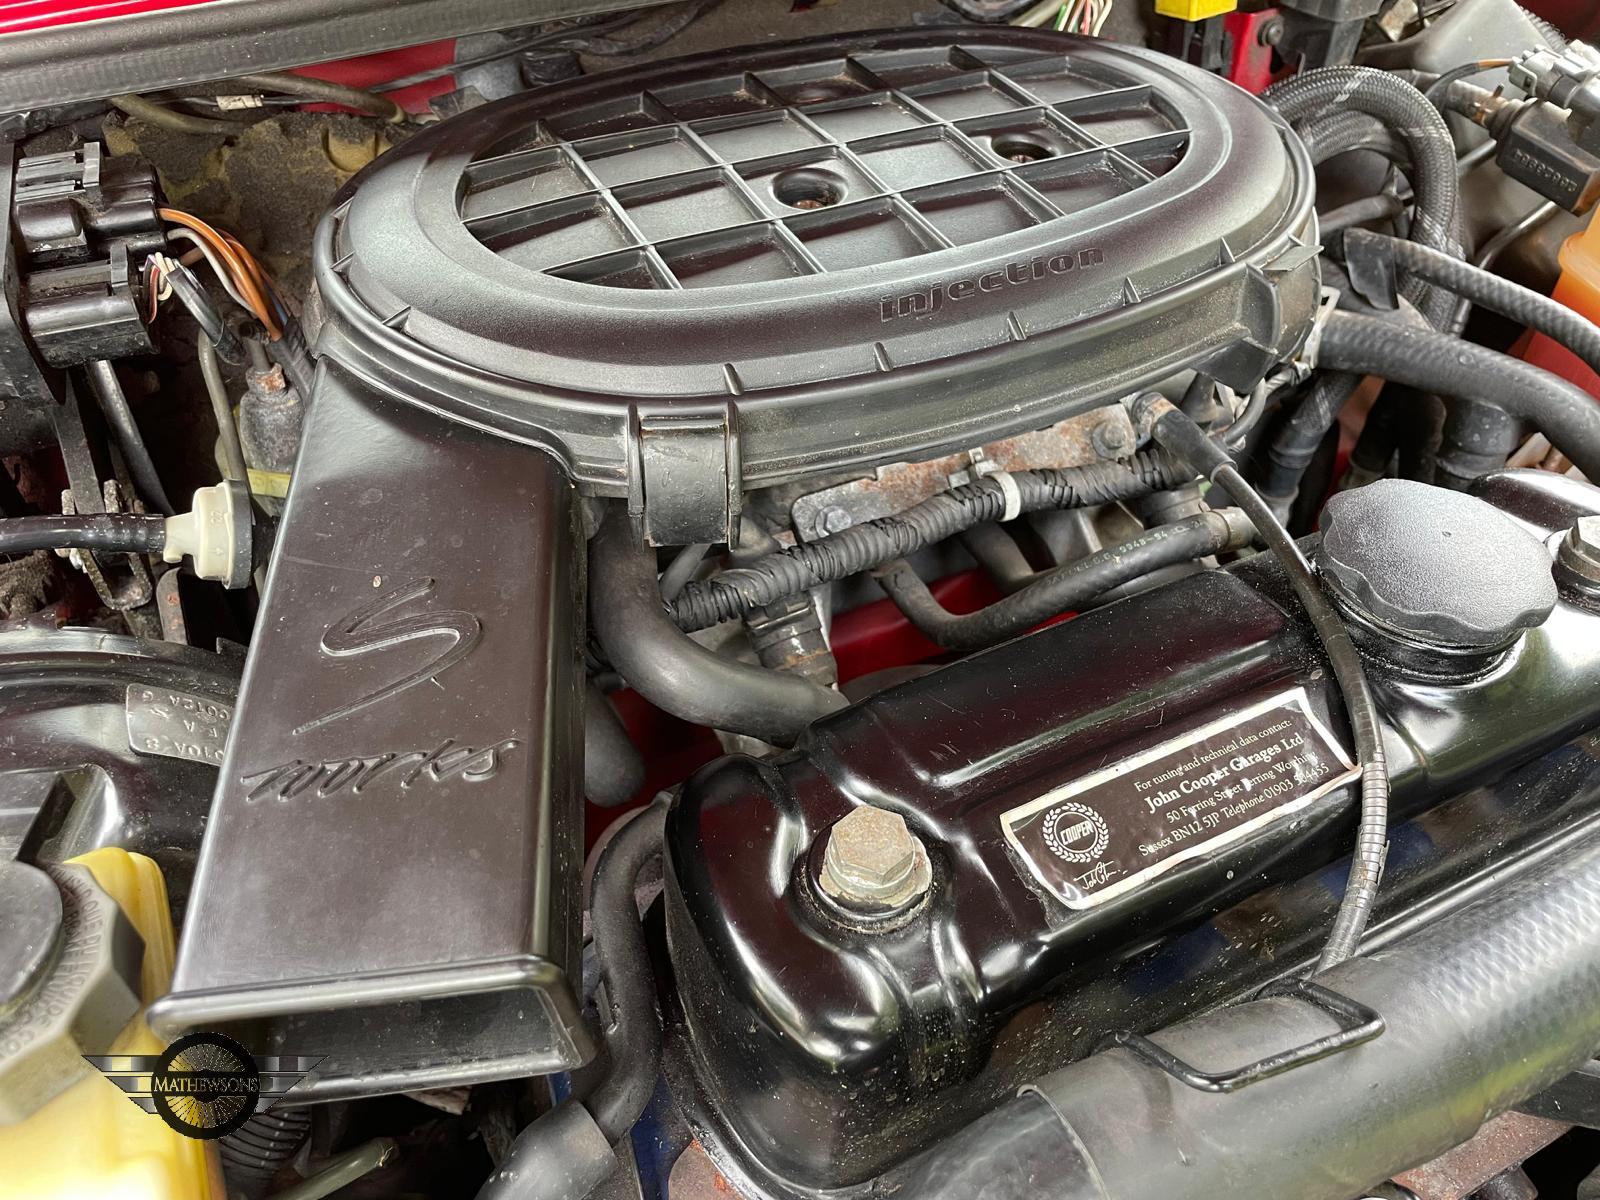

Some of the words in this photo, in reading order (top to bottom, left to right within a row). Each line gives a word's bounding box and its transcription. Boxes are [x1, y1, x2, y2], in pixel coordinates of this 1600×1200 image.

[880, 247, 1104, 322] injection
[291, 576, 483, 735] S
[240, 738, 520, 801] works
[1134, 780, 1152, 792] For
[1152, 767, 1184, 784] tuning
[1183, 757, 1200, 772] and
[1200, 740, 1239, 763] technical
[1239, 736, 1259, 747] data
[1258, 720, 1293, 738] contact:
[1144, 789, 1181, 814] John
[1180, 766, 1230, 793] Cooper
[1230, 743, 1282, 771] Garages
[1280, 732, 1304, 750] Ltd
[1060, 820, 1094, 845] COOPER
[1138, 837, 1174, 856] Sussex
[1170, 821, 1203, 841] BN12
[1202, 812, 1220, 828] 5JP
[1220, 794, 1265, 818] Telephone
[1263, 779, 1294, 799] 01903
[1166, 810, 1181, 823] 50
[1179, 797, 1217, 817] Ferring
[1240, 770, 1276, 791] erring
